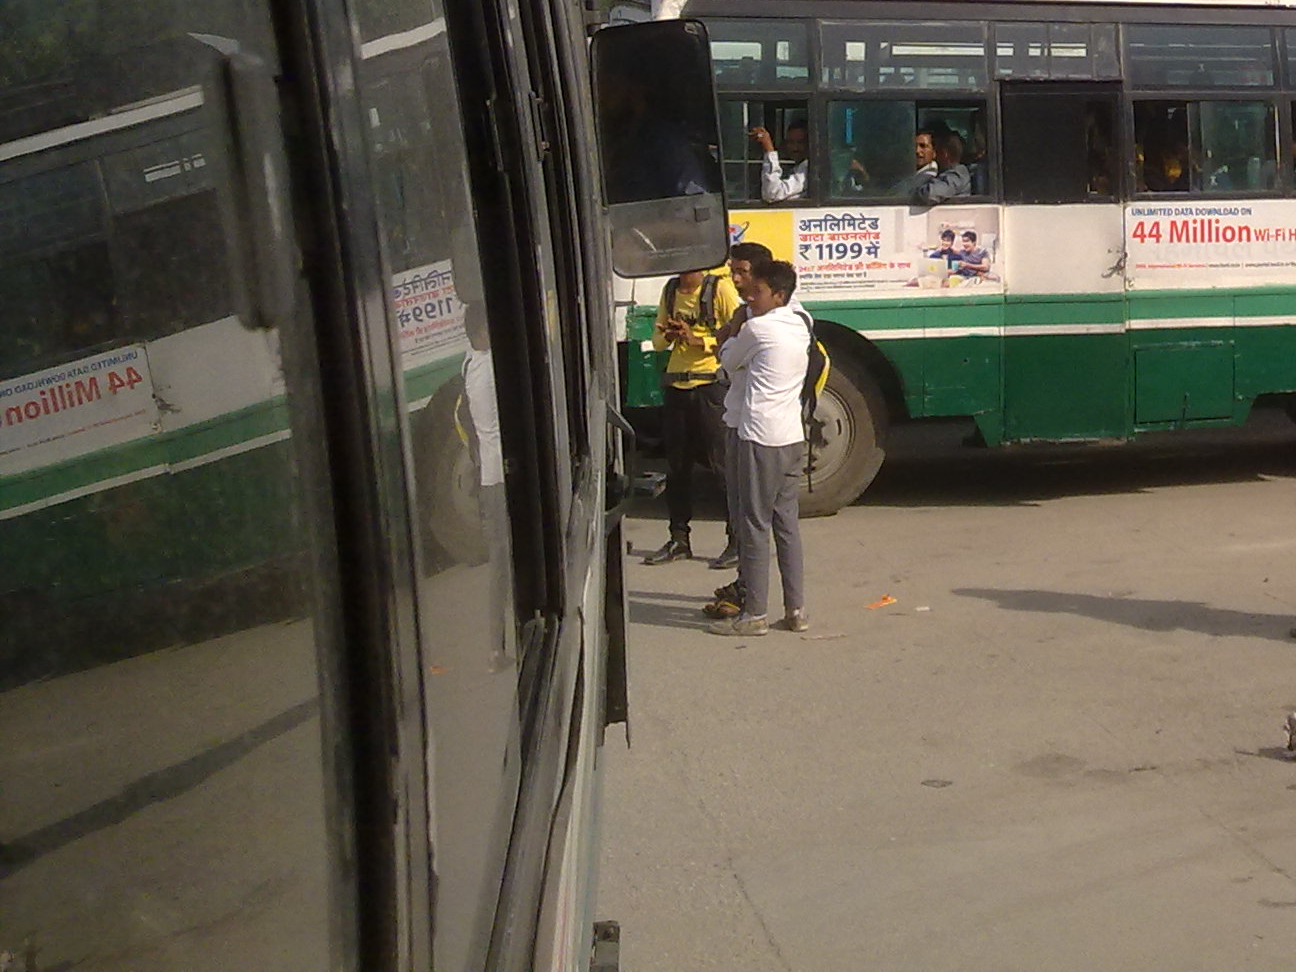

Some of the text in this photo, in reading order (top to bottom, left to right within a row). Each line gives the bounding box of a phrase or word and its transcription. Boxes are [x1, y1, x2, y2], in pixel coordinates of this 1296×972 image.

[1131, 208, 1252, 216] UNLIMITED DATA DOWNLOAD ON
[798, 213, 880, 232] अनलिमिटेड
[1132, 220, 1162, 243] 44
[1169, 218, 1251, 243] Million
[1253, 228, 1286, 242] Wi-Fi
[799, 230, 880, 242] डाटा डाउनलोड
[865, 240, 880, 259] में
